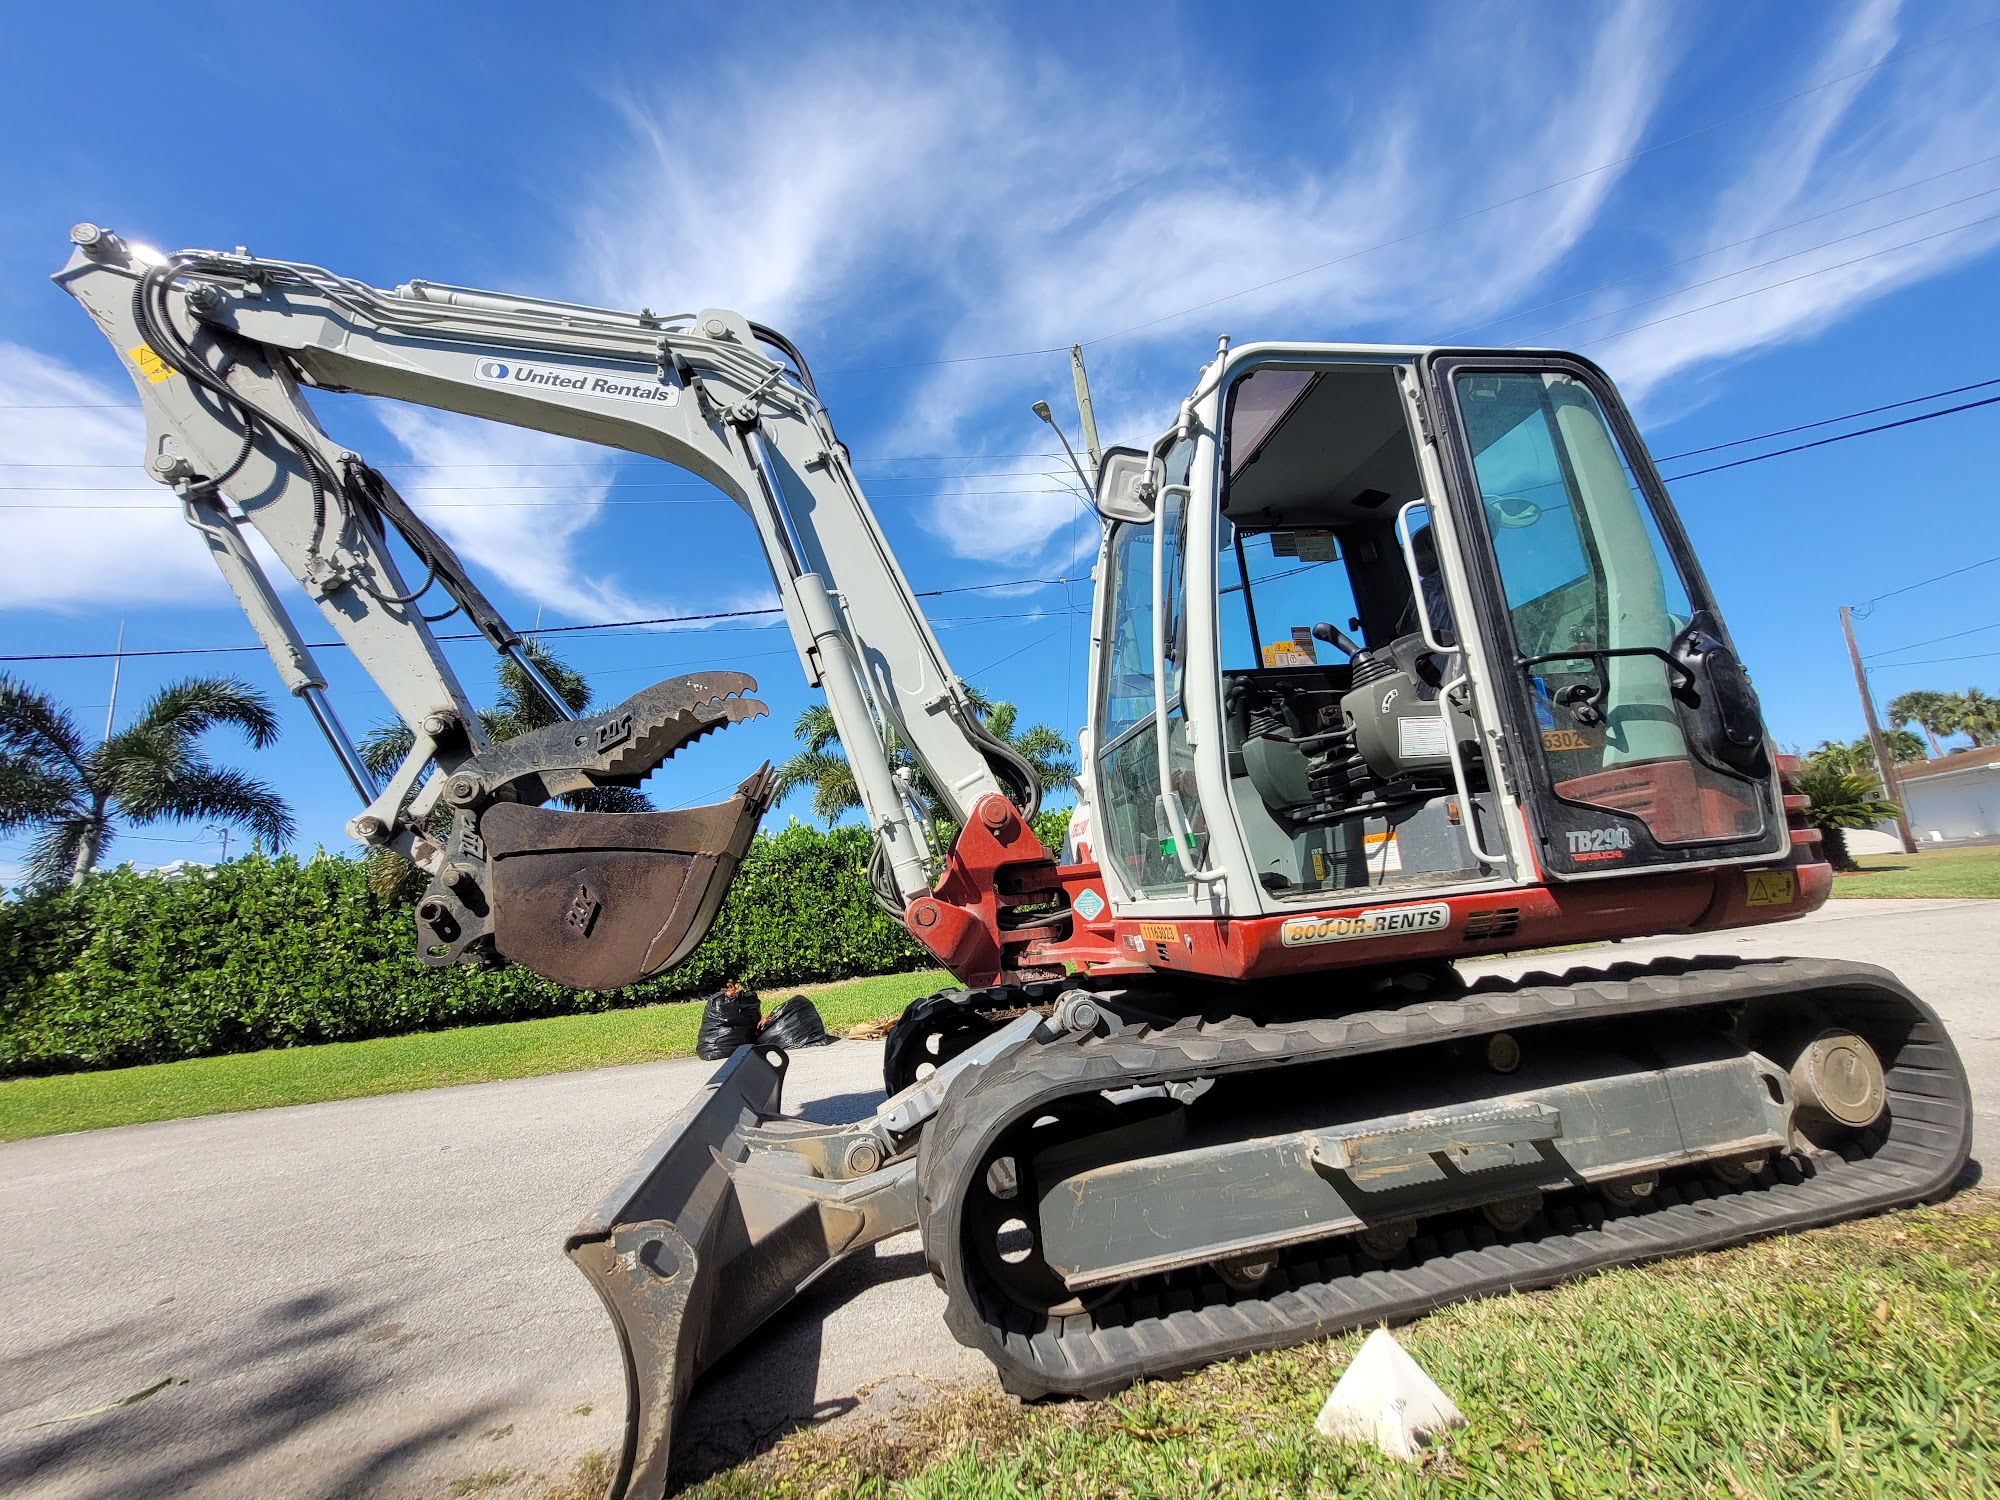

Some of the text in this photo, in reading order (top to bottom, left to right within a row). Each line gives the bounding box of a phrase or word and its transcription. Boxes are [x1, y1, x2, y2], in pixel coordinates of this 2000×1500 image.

[514, 366, 669, 401] United Rentals
[1565, 826, 1632, 853] TB290
[1143, 926, 1175, 941] 11163023
